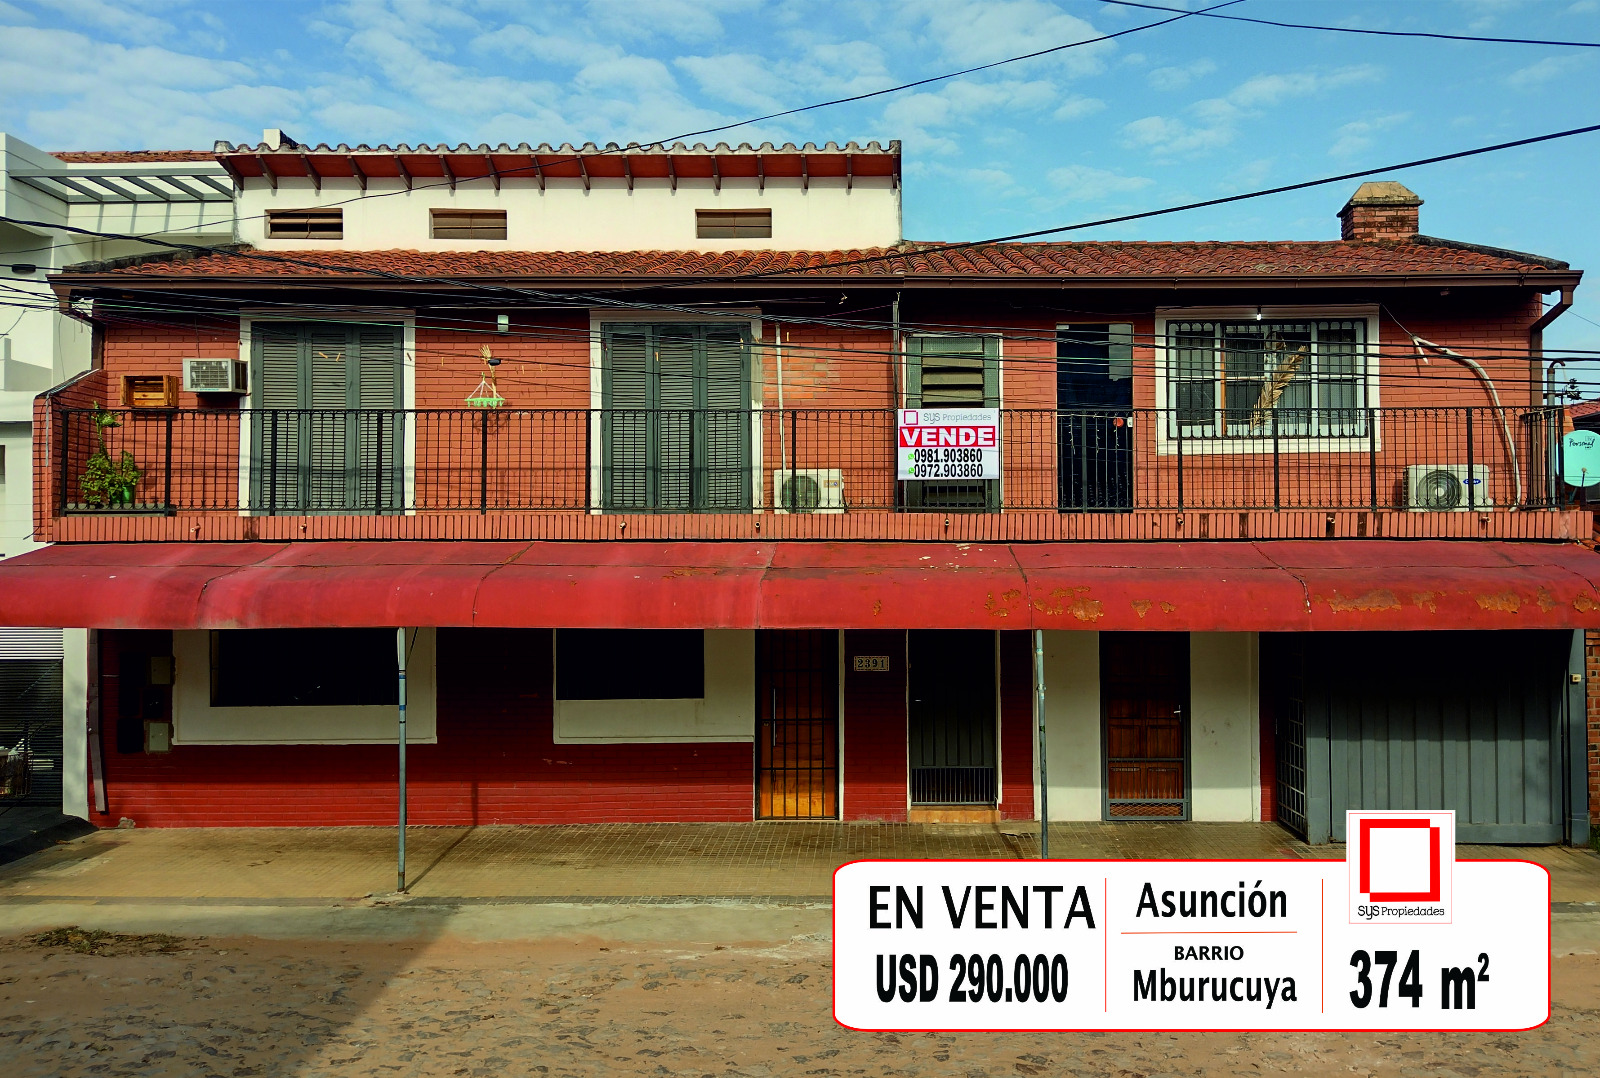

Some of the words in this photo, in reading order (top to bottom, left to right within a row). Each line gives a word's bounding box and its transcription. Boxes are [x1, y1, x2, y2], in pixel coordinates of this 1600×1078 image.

[943, 413, 992, 422] Propiedades
[901, 427, 994, 446] VENDE
[914, 448, 983, 463] 0981.903860
[914, 464, 983, 477] 0972.903860
[857, 659, 885, 668] 2391
